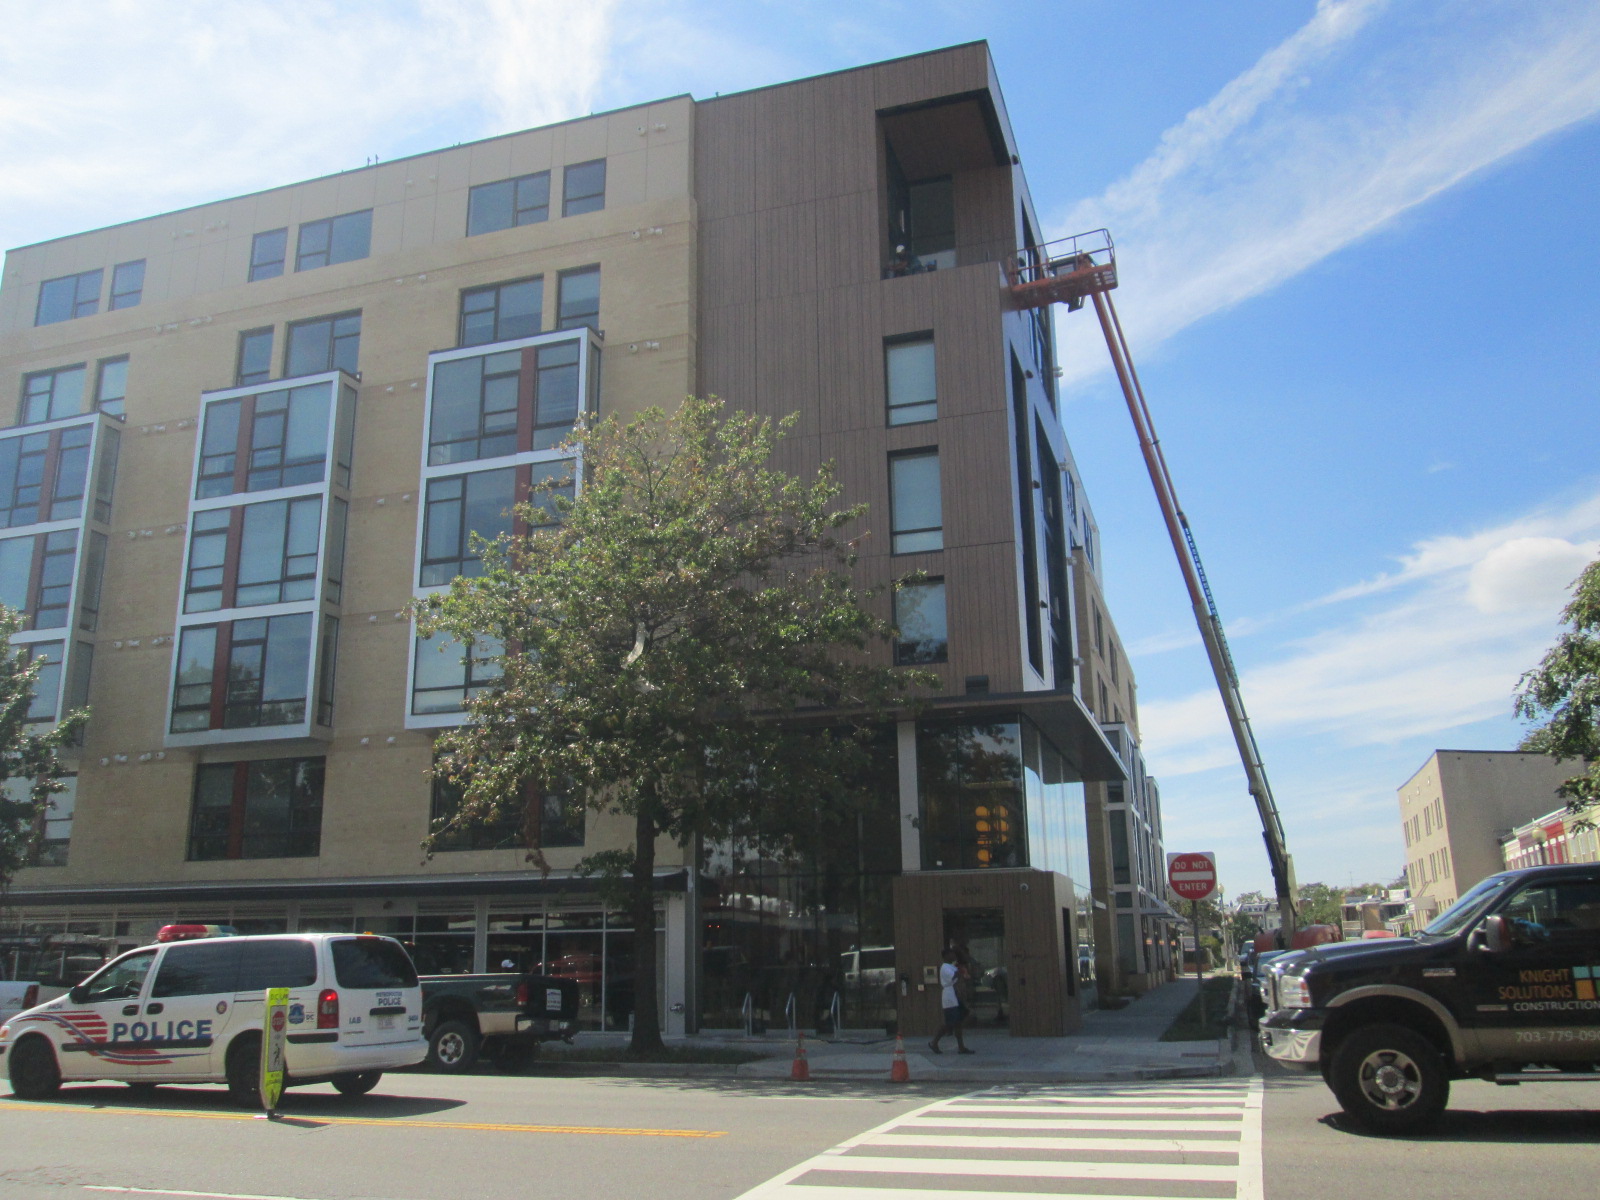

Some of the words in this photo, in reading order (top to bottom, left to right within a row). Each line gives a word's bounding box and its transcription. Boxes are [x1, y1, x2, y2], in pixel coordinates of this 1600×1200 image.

[1174, 861, 1187, 870] DO
[1192, 860, 1209, 870] NOT
[1179, 882, 1207, 891] ENTER
[1519, 968, 1569, 983] KNIGHT
[1498, 984, 1573, 1000] SOLUTIONS
[378, 998, 402, 1006] POLICE
[1513, 1000, 1600, 1011] CONSTRUCTION
[112, 1019, 213, 1043] POLICE
